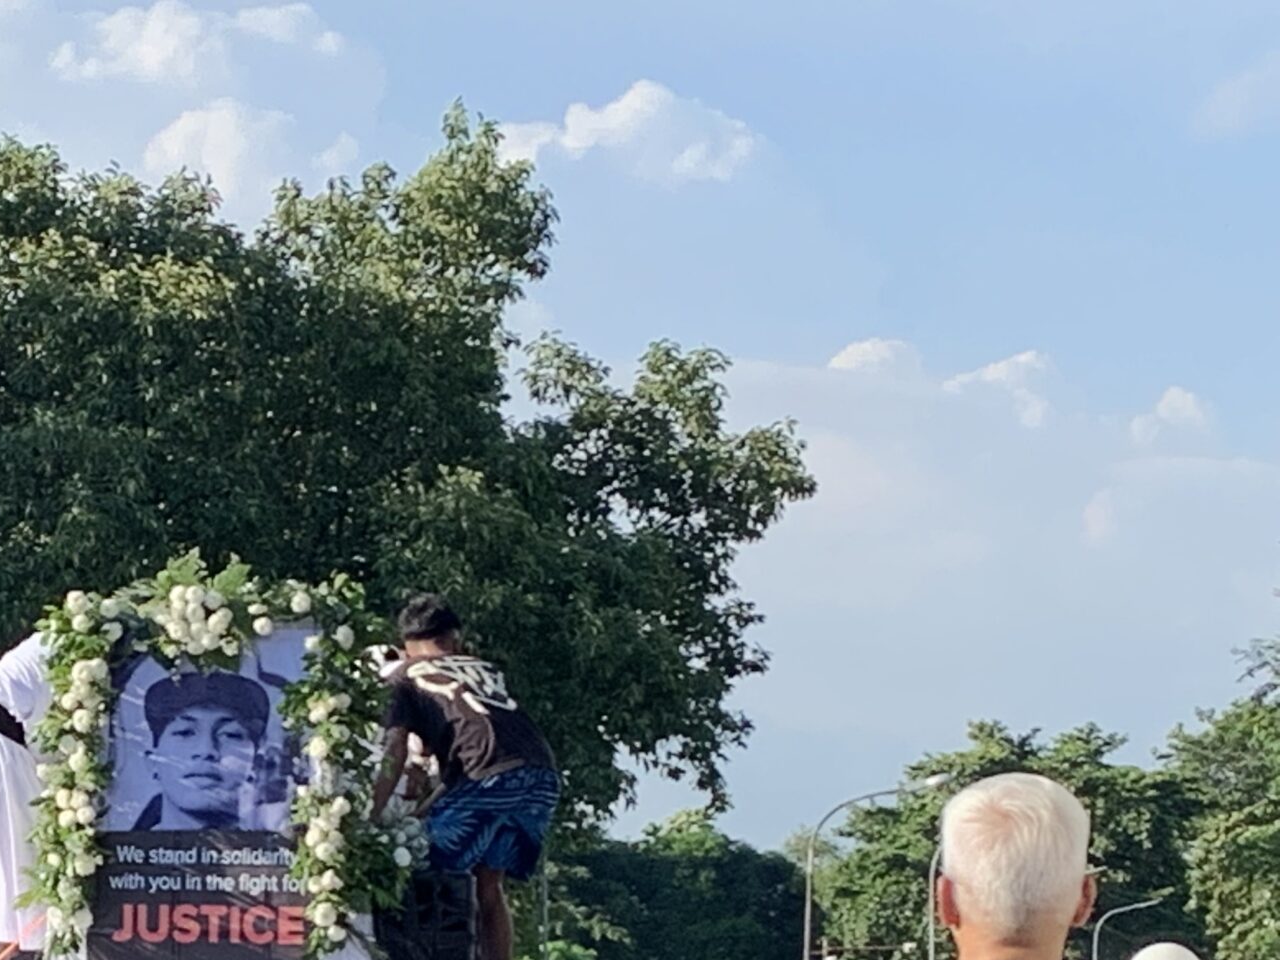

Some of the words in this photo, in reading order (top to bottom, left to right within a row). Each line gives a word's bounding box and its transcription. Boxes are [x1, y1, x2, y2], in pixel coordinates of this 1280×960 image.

[116, 845, 145, 864] We
[148, 847, 198, 864] stand
[200, 847, 219, 864] in
[221, 847, 298, 869] solidarity
[109, 872, 145, 890] with
[148, 876, 182, 894] you
[185, 873, 202, 891] in
[205, 874, 236, 891] the
[238, 873, 279, 896] fight
[111, 903, 305, 946] JUSTICE
